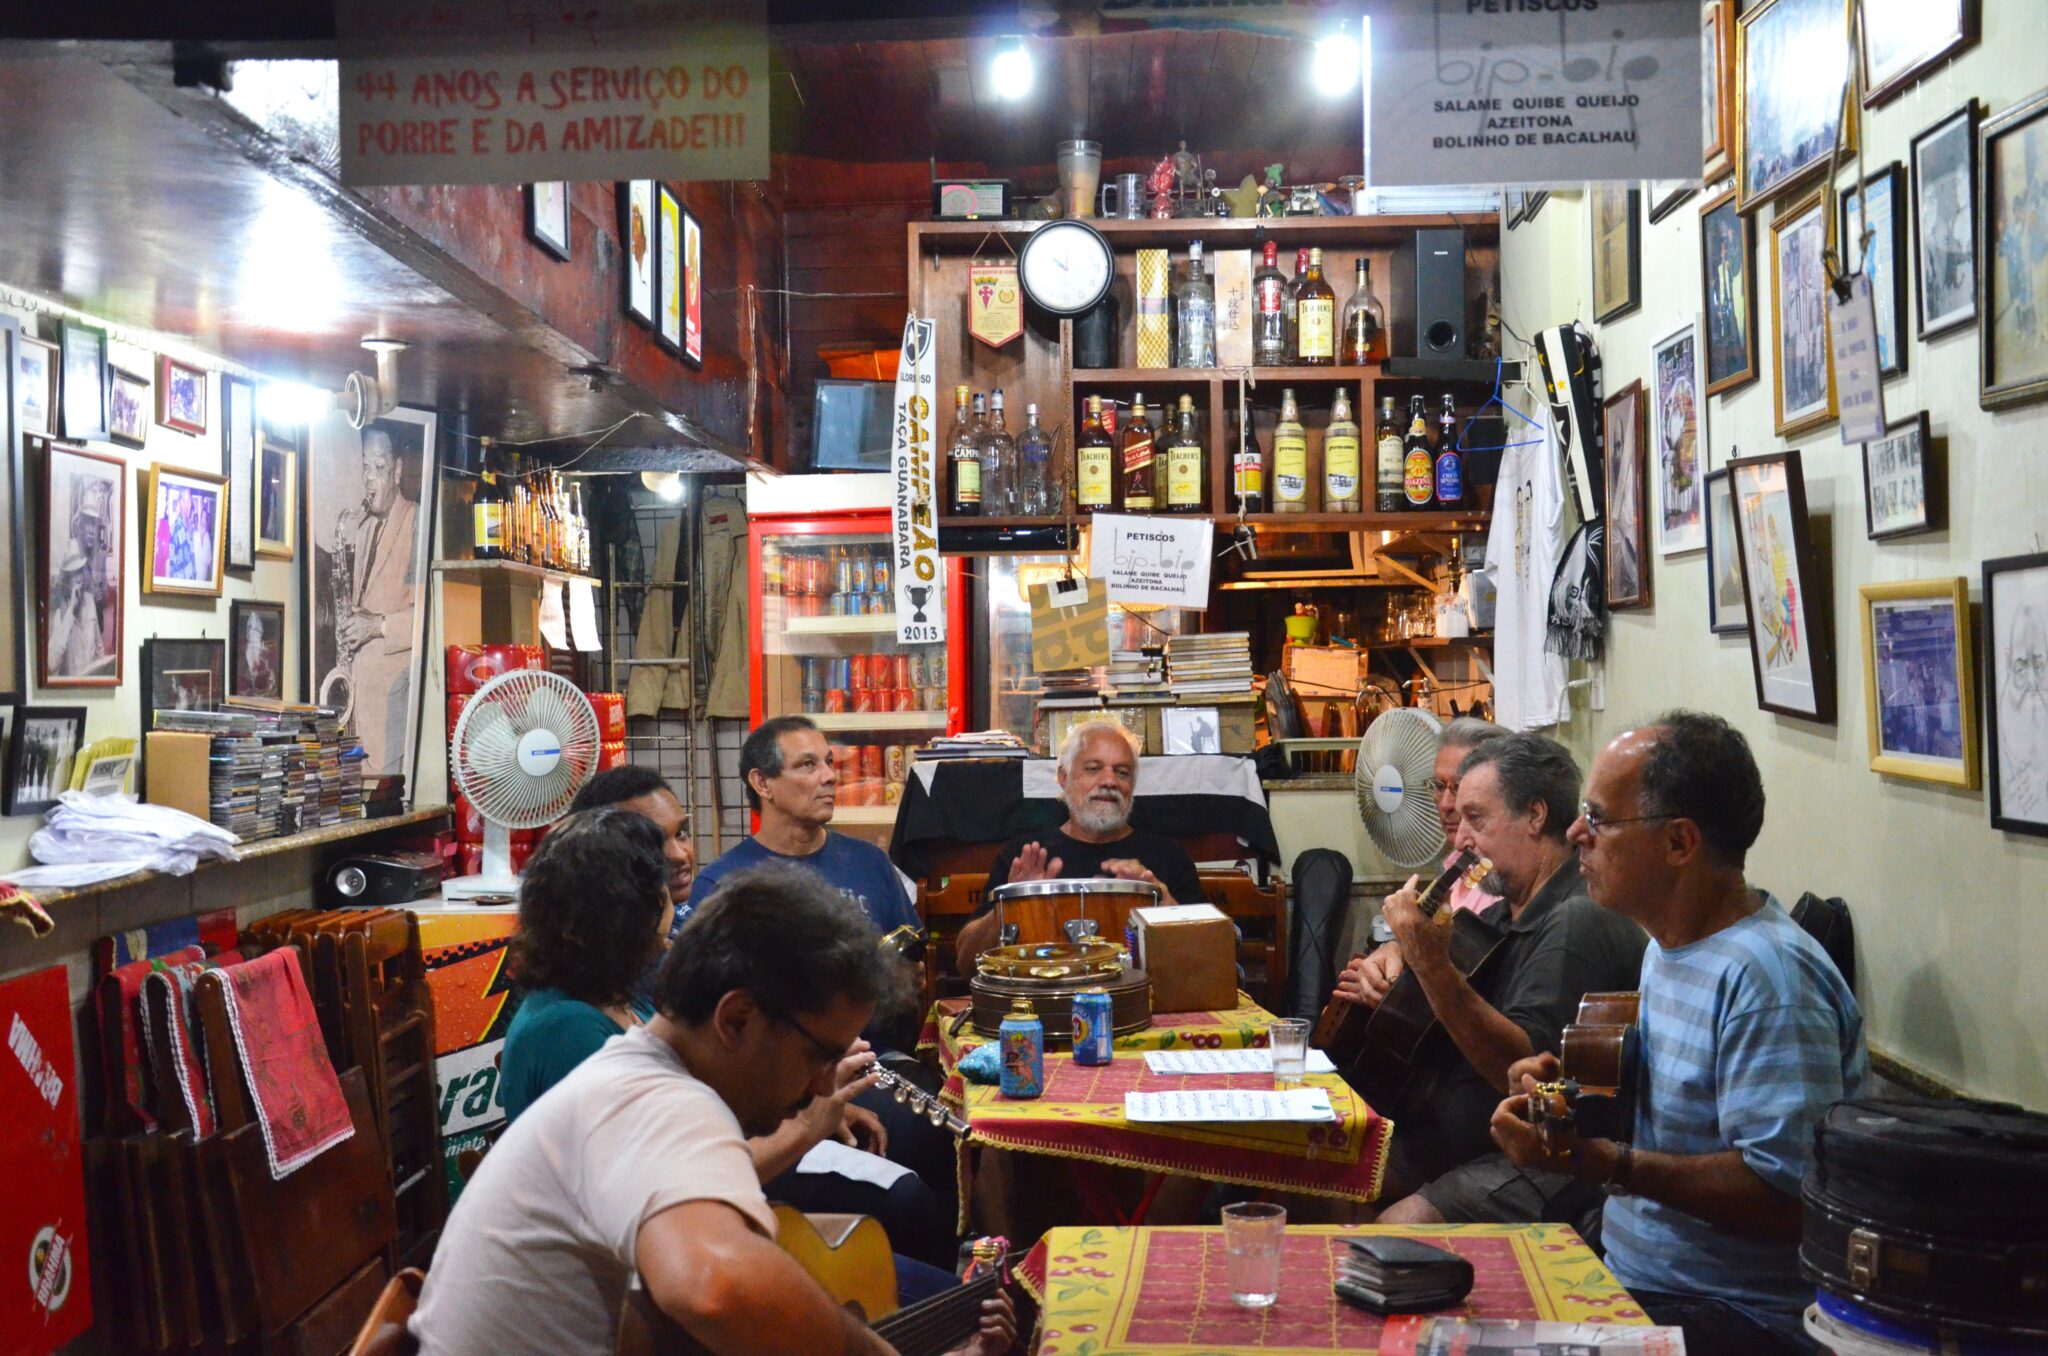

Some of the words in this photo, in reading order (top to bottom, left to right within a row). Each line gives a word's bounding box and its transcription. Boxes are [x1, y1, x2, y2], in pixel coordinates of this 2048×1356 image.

[356, 69, 397, 101] 44
[411, 69, 500, 112] ANOS
[515, 70, 539, 101] A
[542, 64, 692, 113] SERVIÇO
[702, 64, 749, 100] DO
[1433, 98, 1502, 113] SALAME
[1512, 96, 1566, 111] QUIBE
[1576, 94, 1640, 109] QUEIJO
[1487, 114, 1573, 130] AZEITONA
[356, 118, 460, 157] PORRE
[471, 117, 494, 154] E
[505, 118, 549, 154] DA
[1433, 133, 1511, 150] BOLINHO
[1515, 132, 1538, 147] DE
[1543, 130, 1637, 146] BACALHAU
[896, 455, 912, 570] GUANABARA
[1127, 533, 1175, 542] PETISCOS
[1112, 569, 1138, 577] SALAME
[1140, 571, 1161, 579] QUIBE
[1163, 572, 1188, 580] QUEIJO
[1111, 583, 1138, 591] BOLINHO
[1140, 584, 1149, 592] DE
[1150, 584, 1185, 594] BACALHAU
[904, 624, 938, 641] 2013
